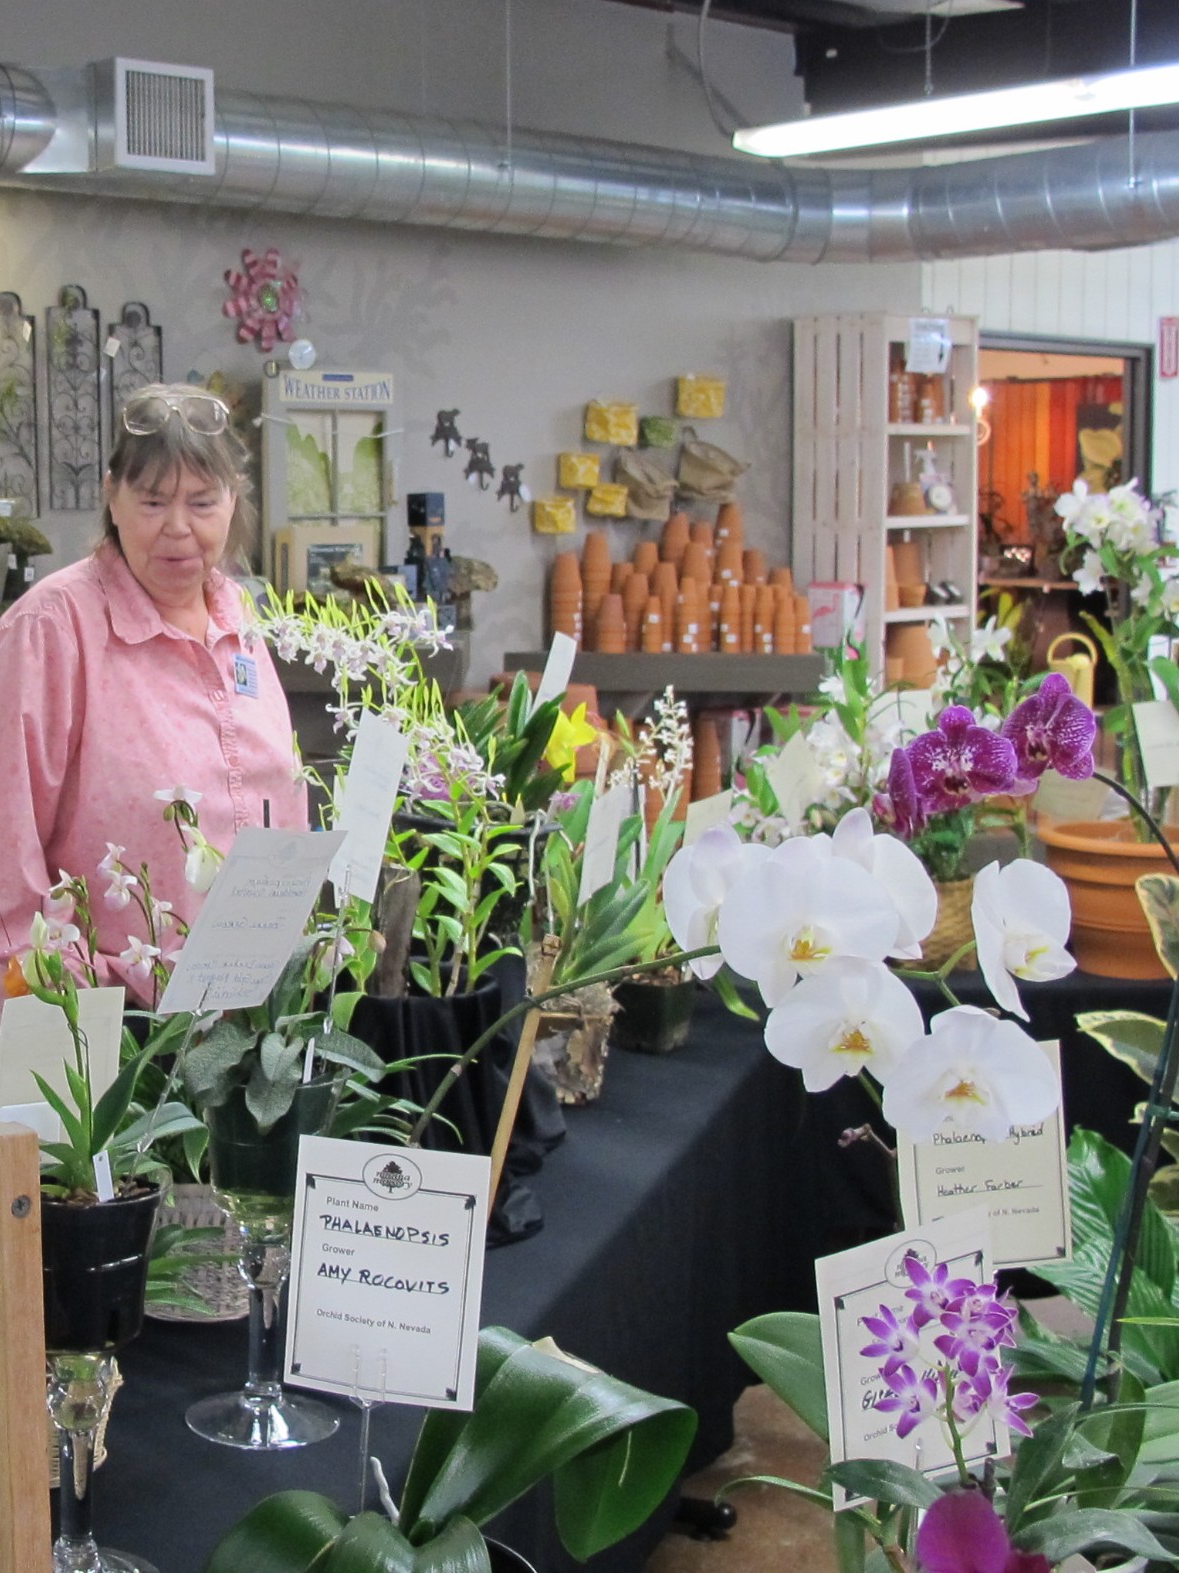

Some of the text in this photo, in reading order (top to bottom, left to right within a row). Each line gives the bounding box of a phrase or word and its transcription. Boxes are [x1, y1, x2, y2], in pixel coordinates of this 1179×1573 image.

[284, 374, 391, 400] WEATHER STATION
[326, 1196, 379, 1212] Plant Name
[319, 1214, 450, 1247] PHALAENOPSIS
[321, 1243, 355, 1256] Grower
[317, 1262, 450, 1295] AMY ROCOVITS
[316, 1308, 431, 1334] Orchid Society of N. Nevada
[864, 1426, 888, 1442] Orchid
